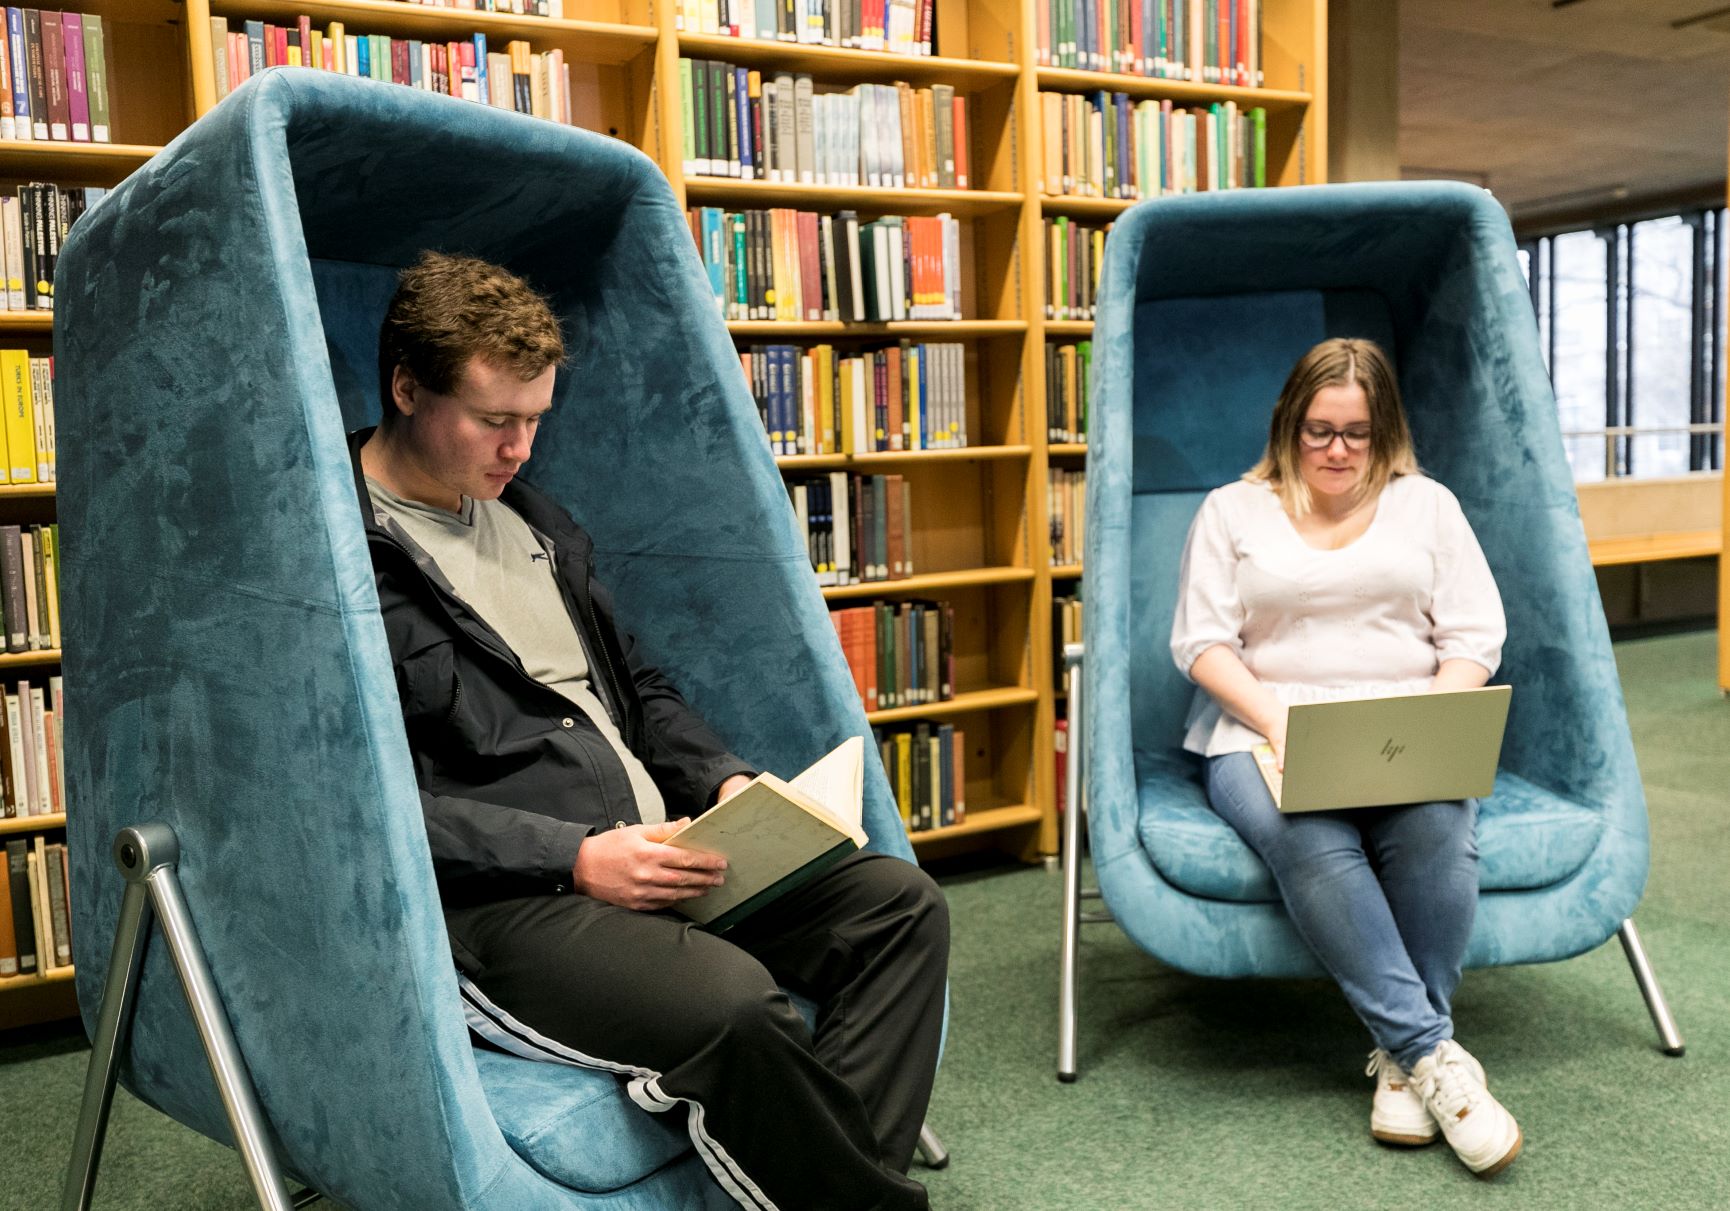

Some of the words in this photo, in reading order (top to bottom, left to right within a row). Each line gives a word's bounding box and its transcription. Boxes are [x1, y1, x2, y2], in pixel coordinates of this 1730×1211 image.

[16, 100, 26, 113] 7
[36, 220, 45, 255] PALESTINE
[49, 220, 57, 255] PALESTINE
